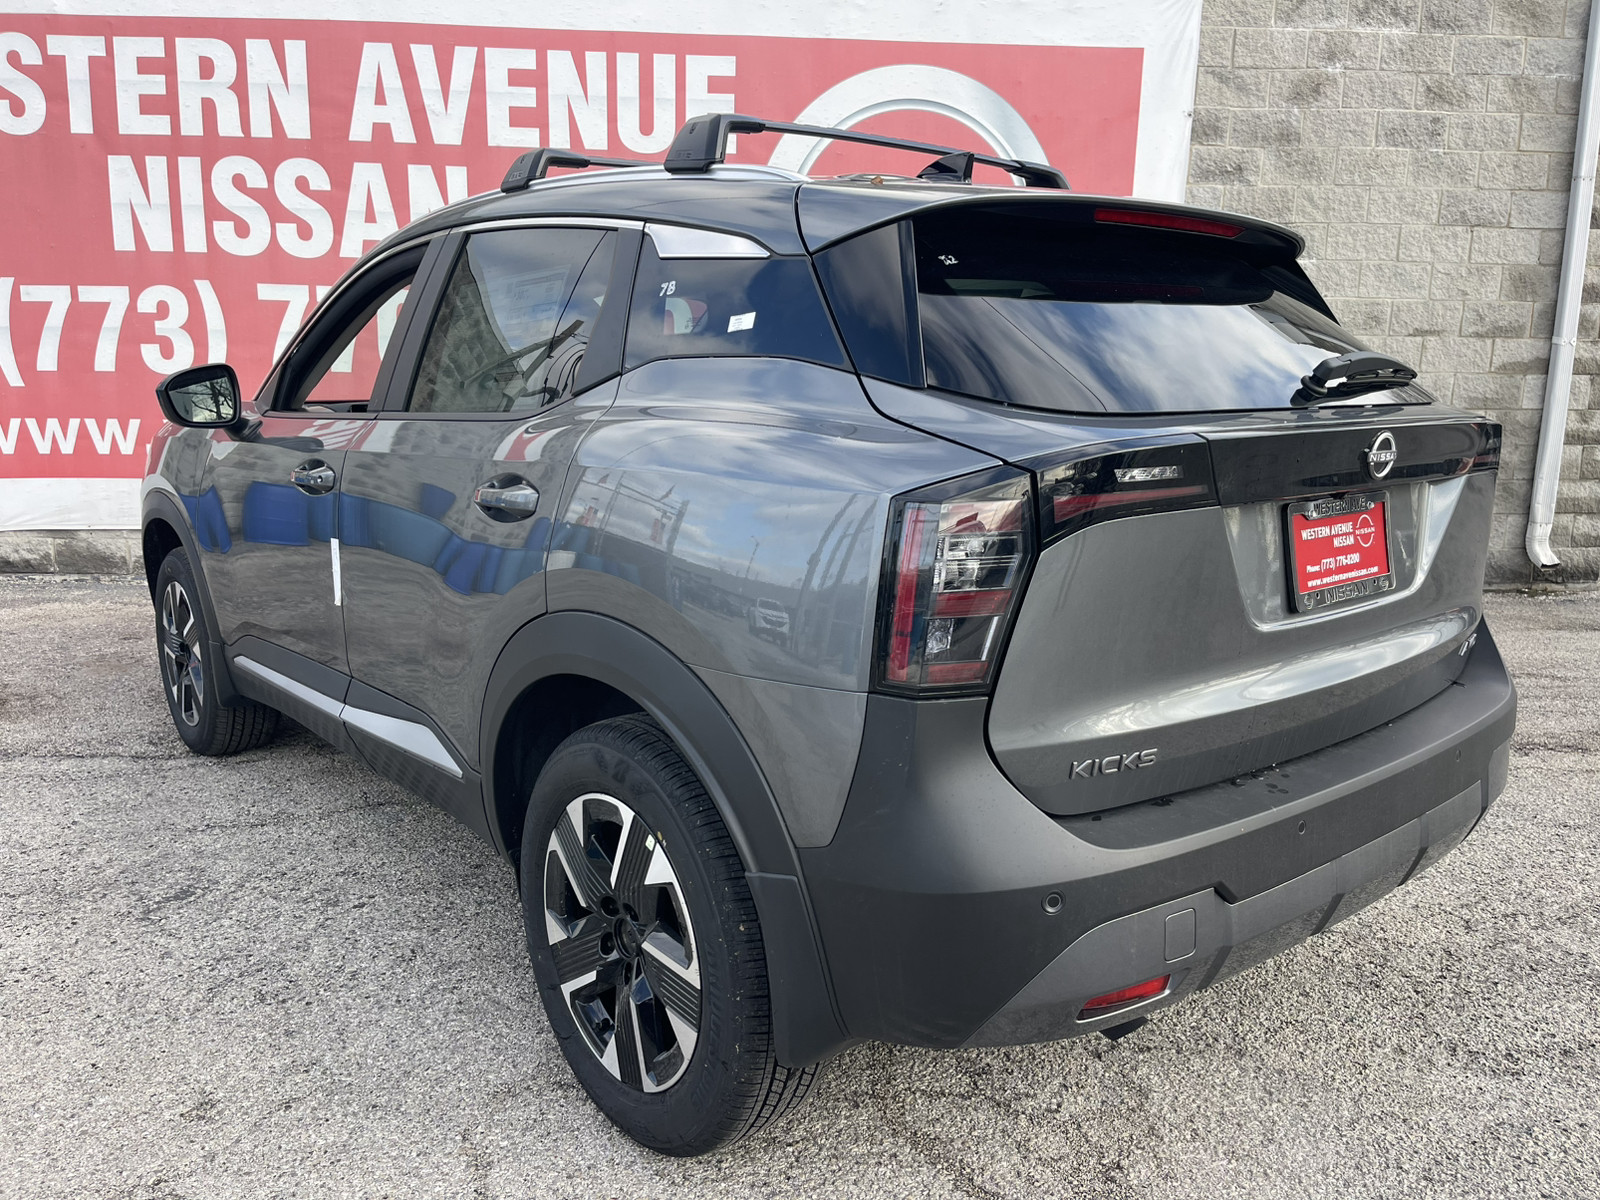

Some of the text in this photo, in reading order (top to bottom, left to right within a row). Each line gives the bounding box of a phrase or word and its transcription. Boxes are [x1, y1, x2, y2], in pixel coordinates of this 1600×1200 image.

[349, 42, 736, 154] AVENUE
[1301, 522, 1354, 541] WESTERN AVENUE
[1333, 534, 1355, 548] NISSAN
[1356, 527, 1375, 535] NISSAN
[1321, 559, 1336, 573] (773)
[1336, 552, 1360, 567] 776-8200
[1307, 566, 1379, 588] www.westernavenissan.com
[1325, 581, 1370, 604] NISSAN
[1069, 748, 1158, 779] KICKS
